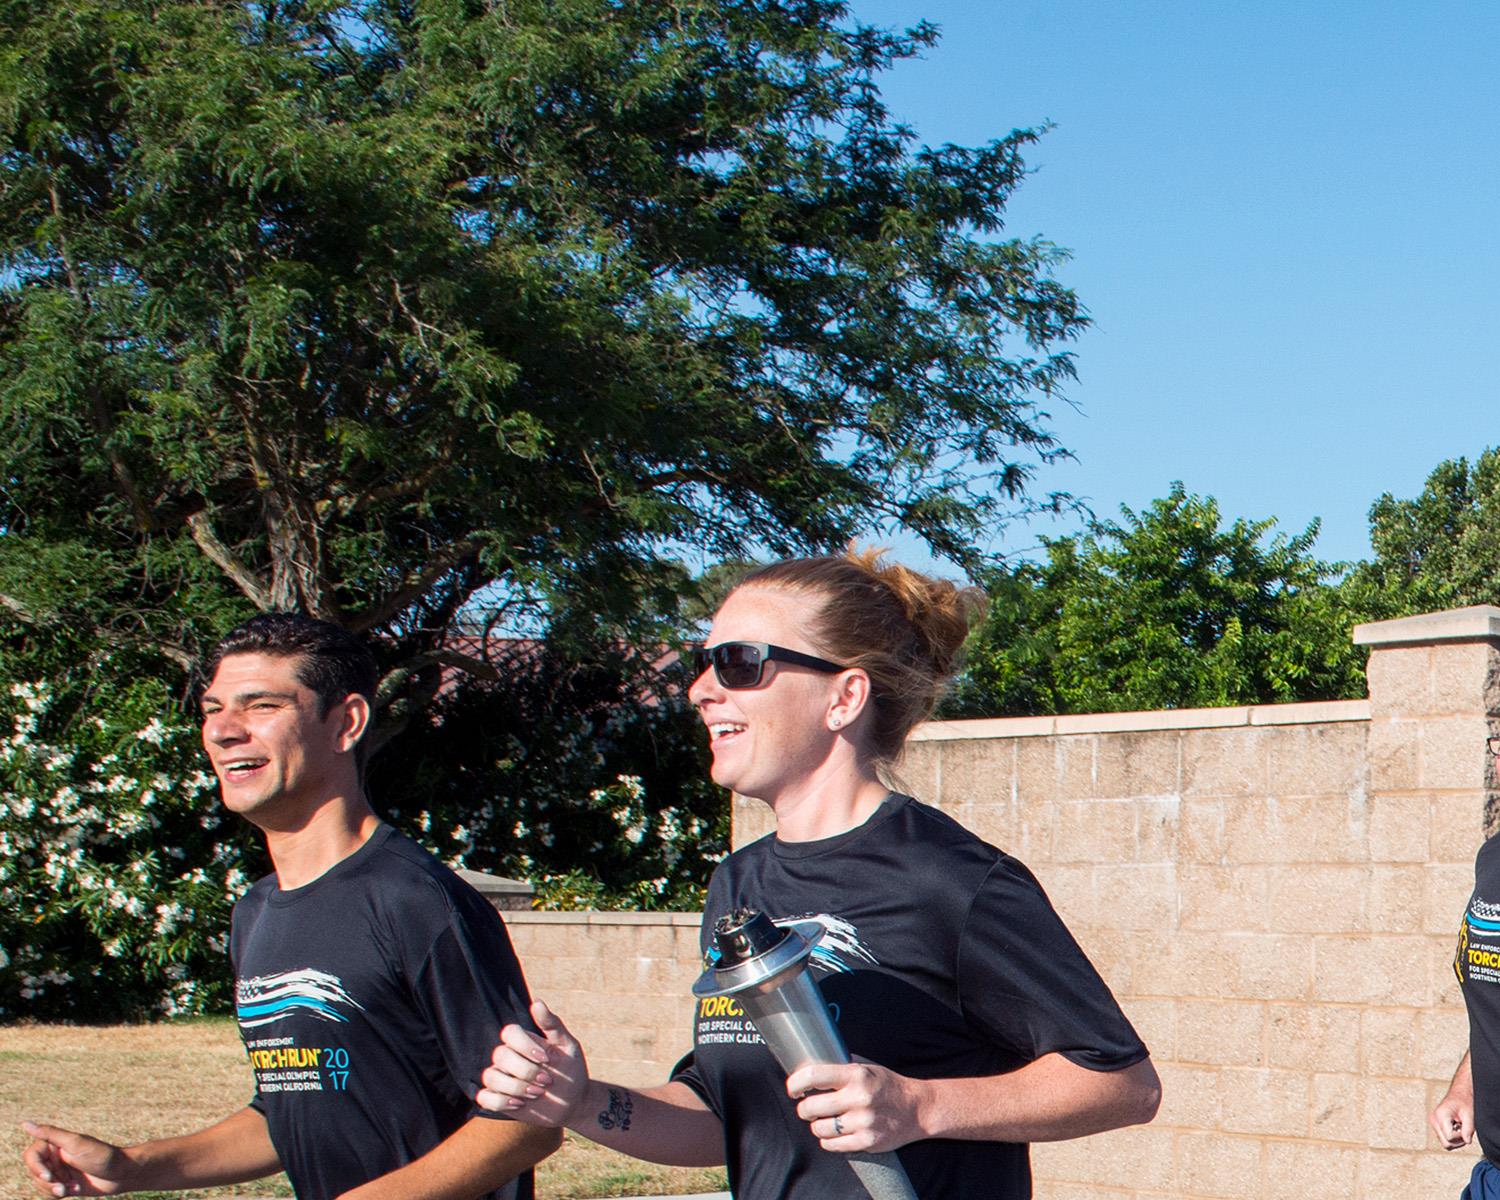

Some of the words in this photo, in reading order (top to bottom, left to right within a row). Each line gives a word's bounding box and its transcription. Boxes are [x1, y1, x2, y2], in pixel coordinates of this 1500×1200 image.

[699, 1021, 710, 1032] FOR
[711, 1021, 743, 1031] SPECIAL
[698, 1034, 735, 1044] NORTHERN
[323, 1048, 349, 1069] 20
[329, 1071, 350, 1090] 17
